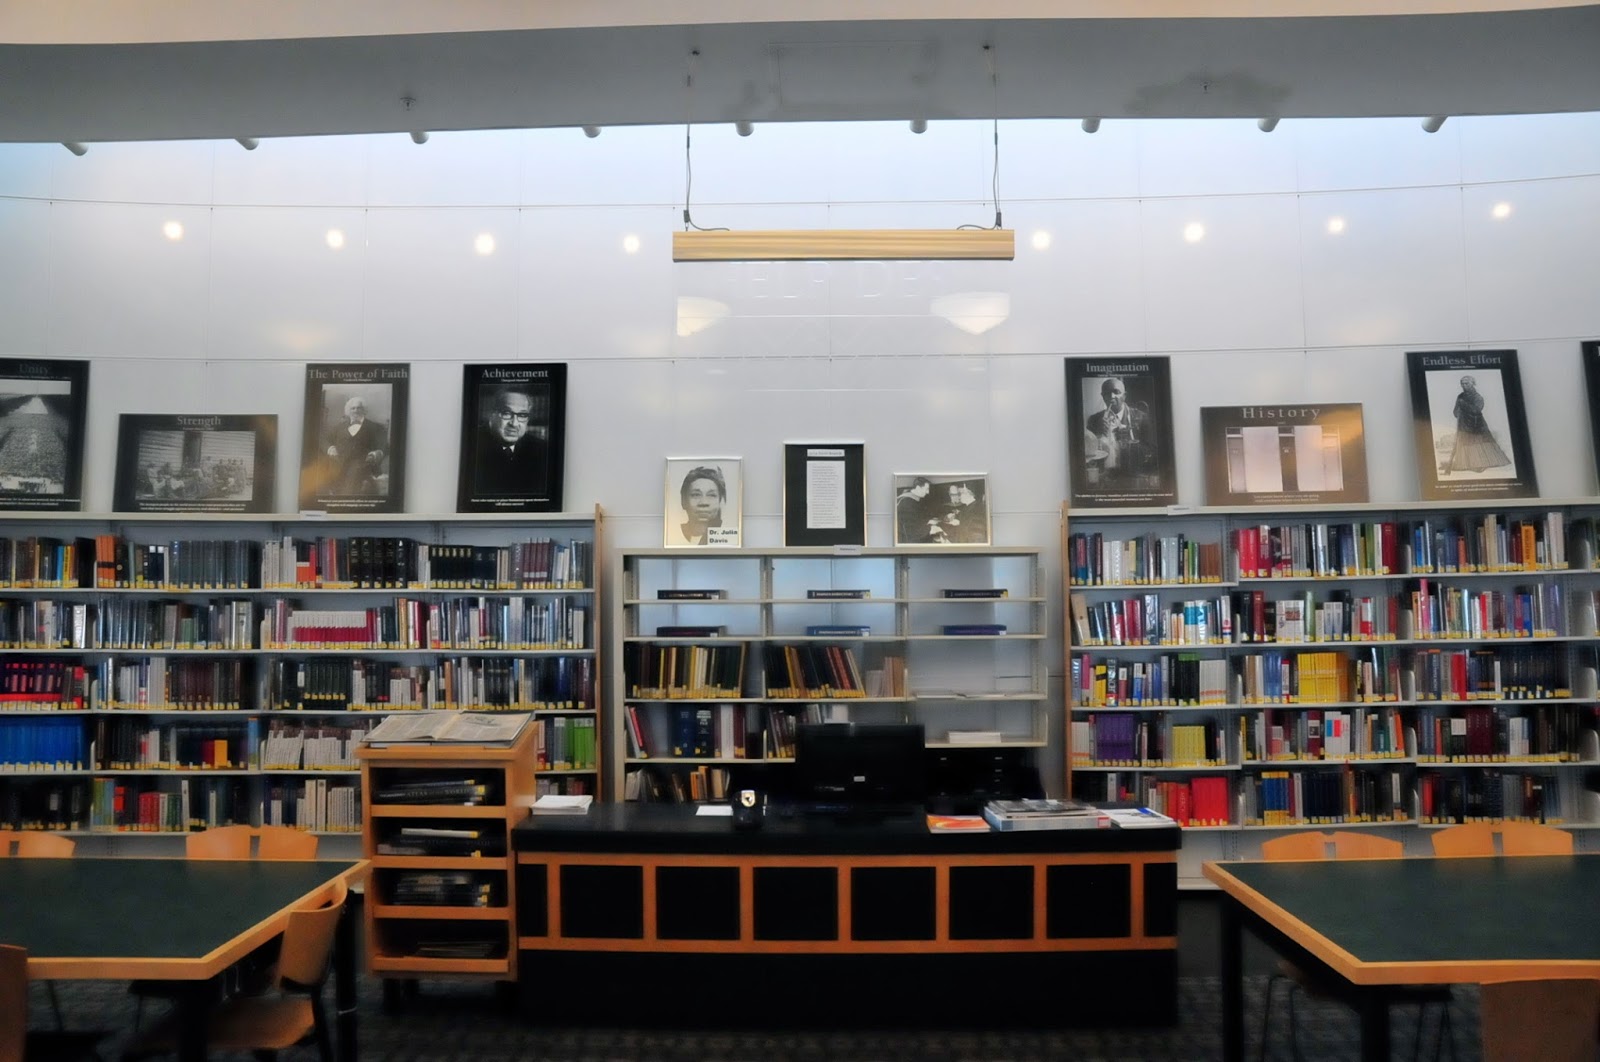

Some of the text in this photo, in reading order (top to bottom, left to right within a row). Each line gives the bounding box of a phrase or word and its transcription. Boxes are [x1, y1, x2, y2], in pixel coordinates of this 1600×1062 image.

[1422, 354, 1502, 366] Endless Effort
[19, 363, 50, 377] Unity
[308, 368, 408, 379] The Power of Faith
[481, 368, 549, 378] Achievement
[1086, 362, 1149, 375] Imagination
[1242, 406, 1320, 421] History
[177, 415, 222, 428] Strength
